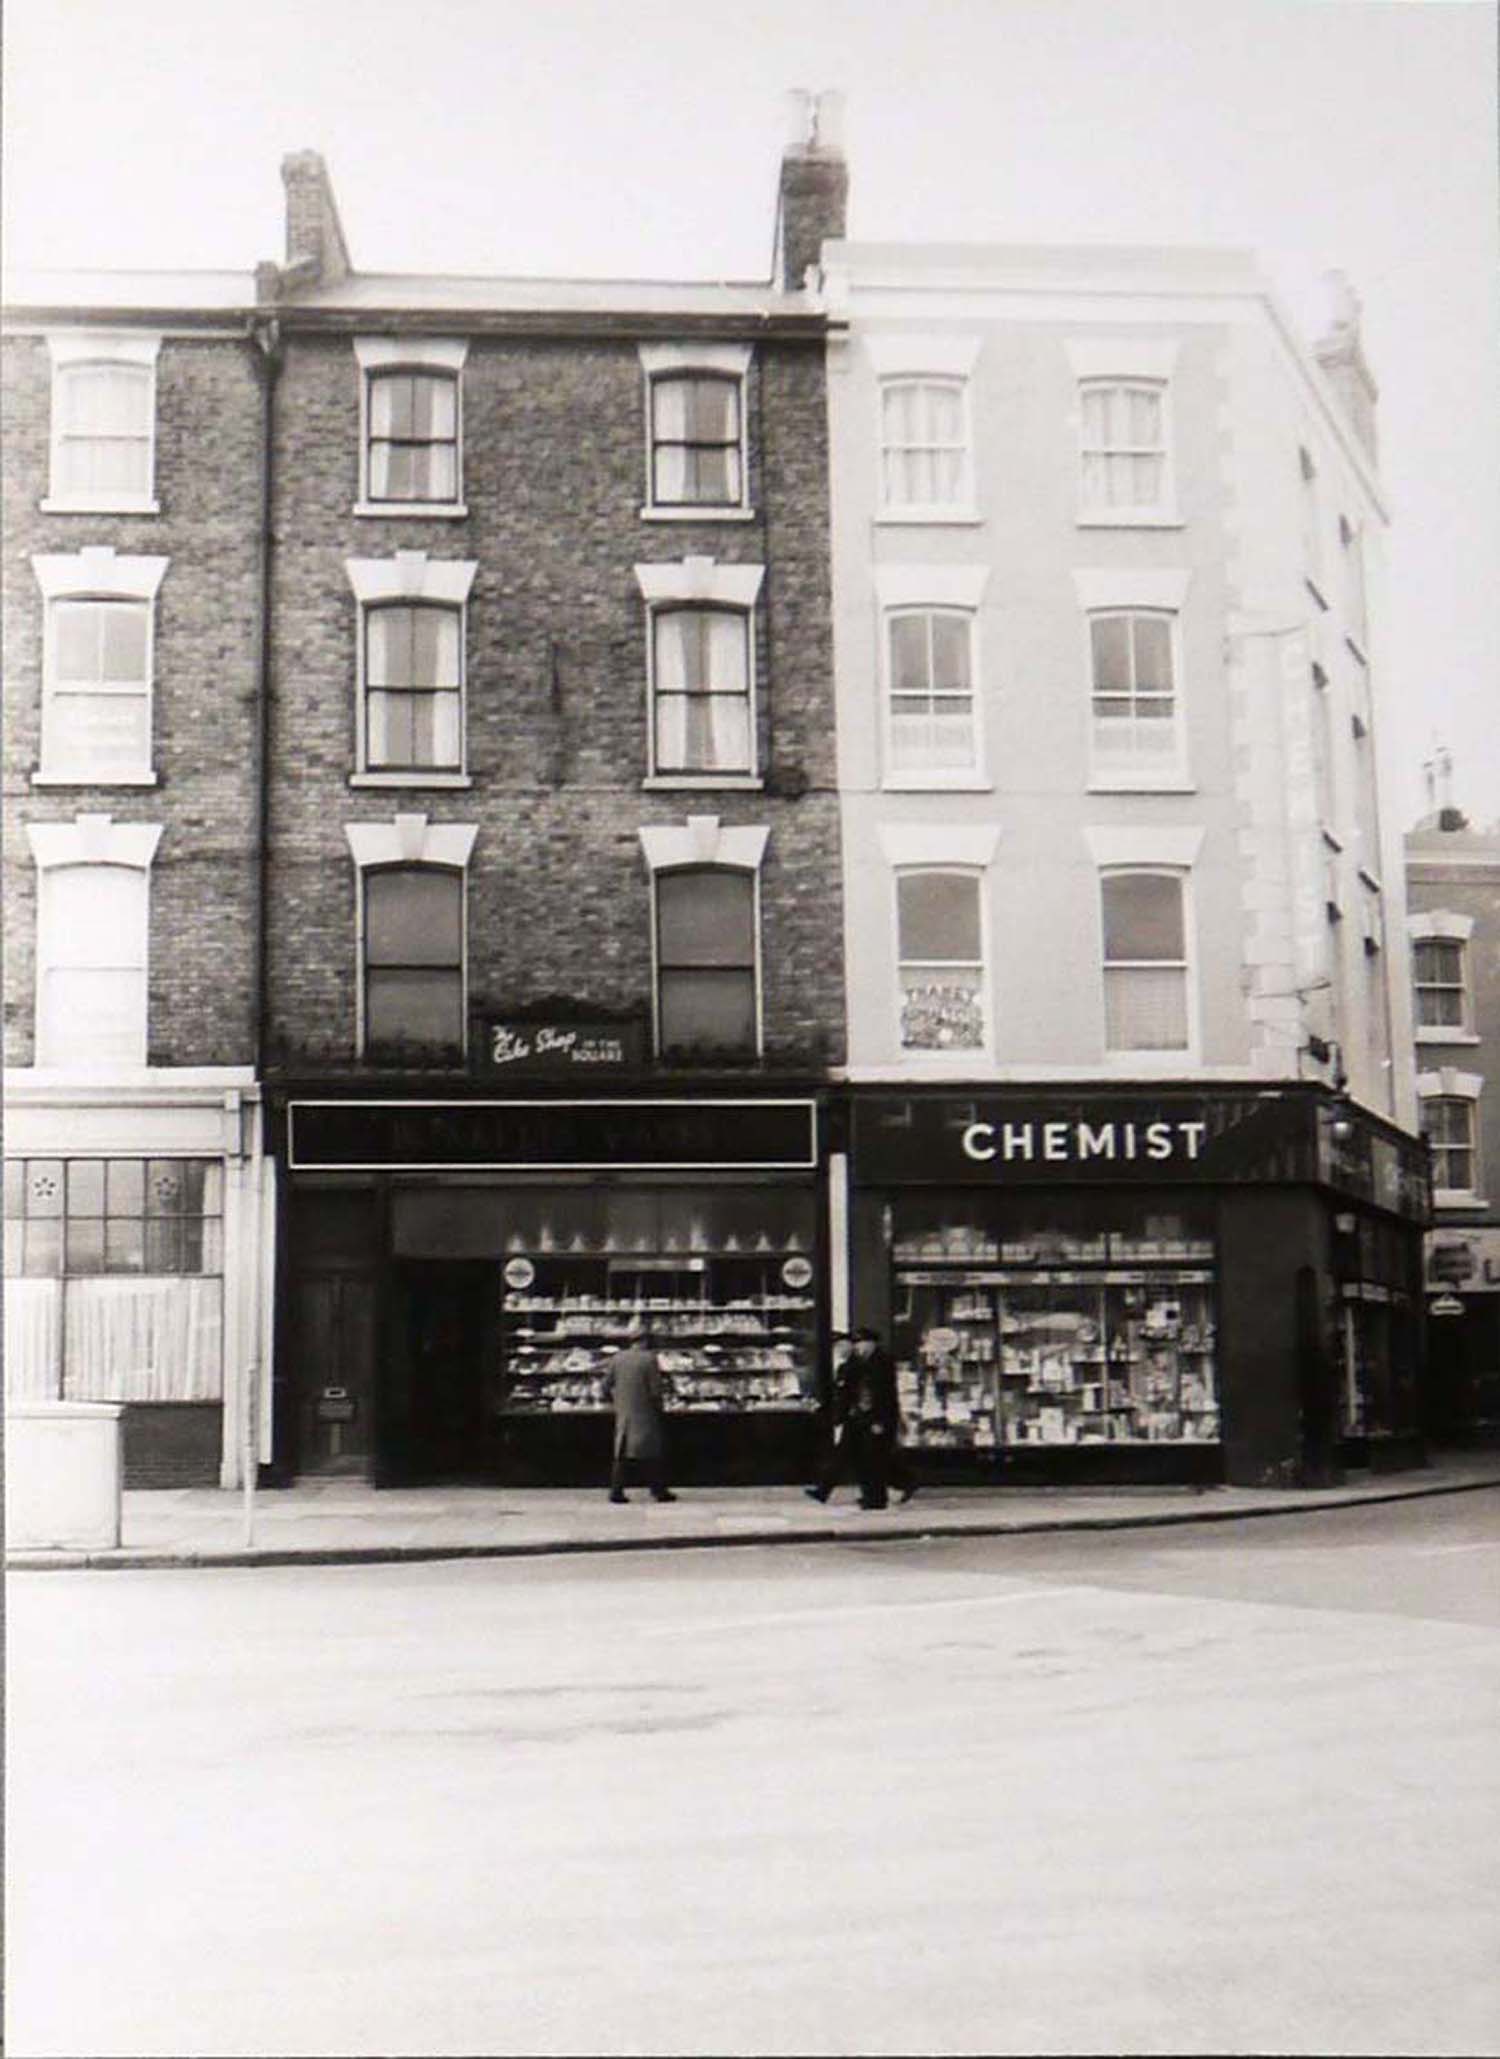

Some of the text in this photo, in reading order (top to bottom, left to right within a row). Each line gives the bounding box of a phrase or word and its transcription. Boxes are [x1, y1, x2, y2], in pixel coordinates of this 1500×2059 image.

[535, 1027, 577, 1053] Shop
[571, 1049, 623, 1062] SQUARE
[962, 1122, 1206, 1161] CHEMIST
